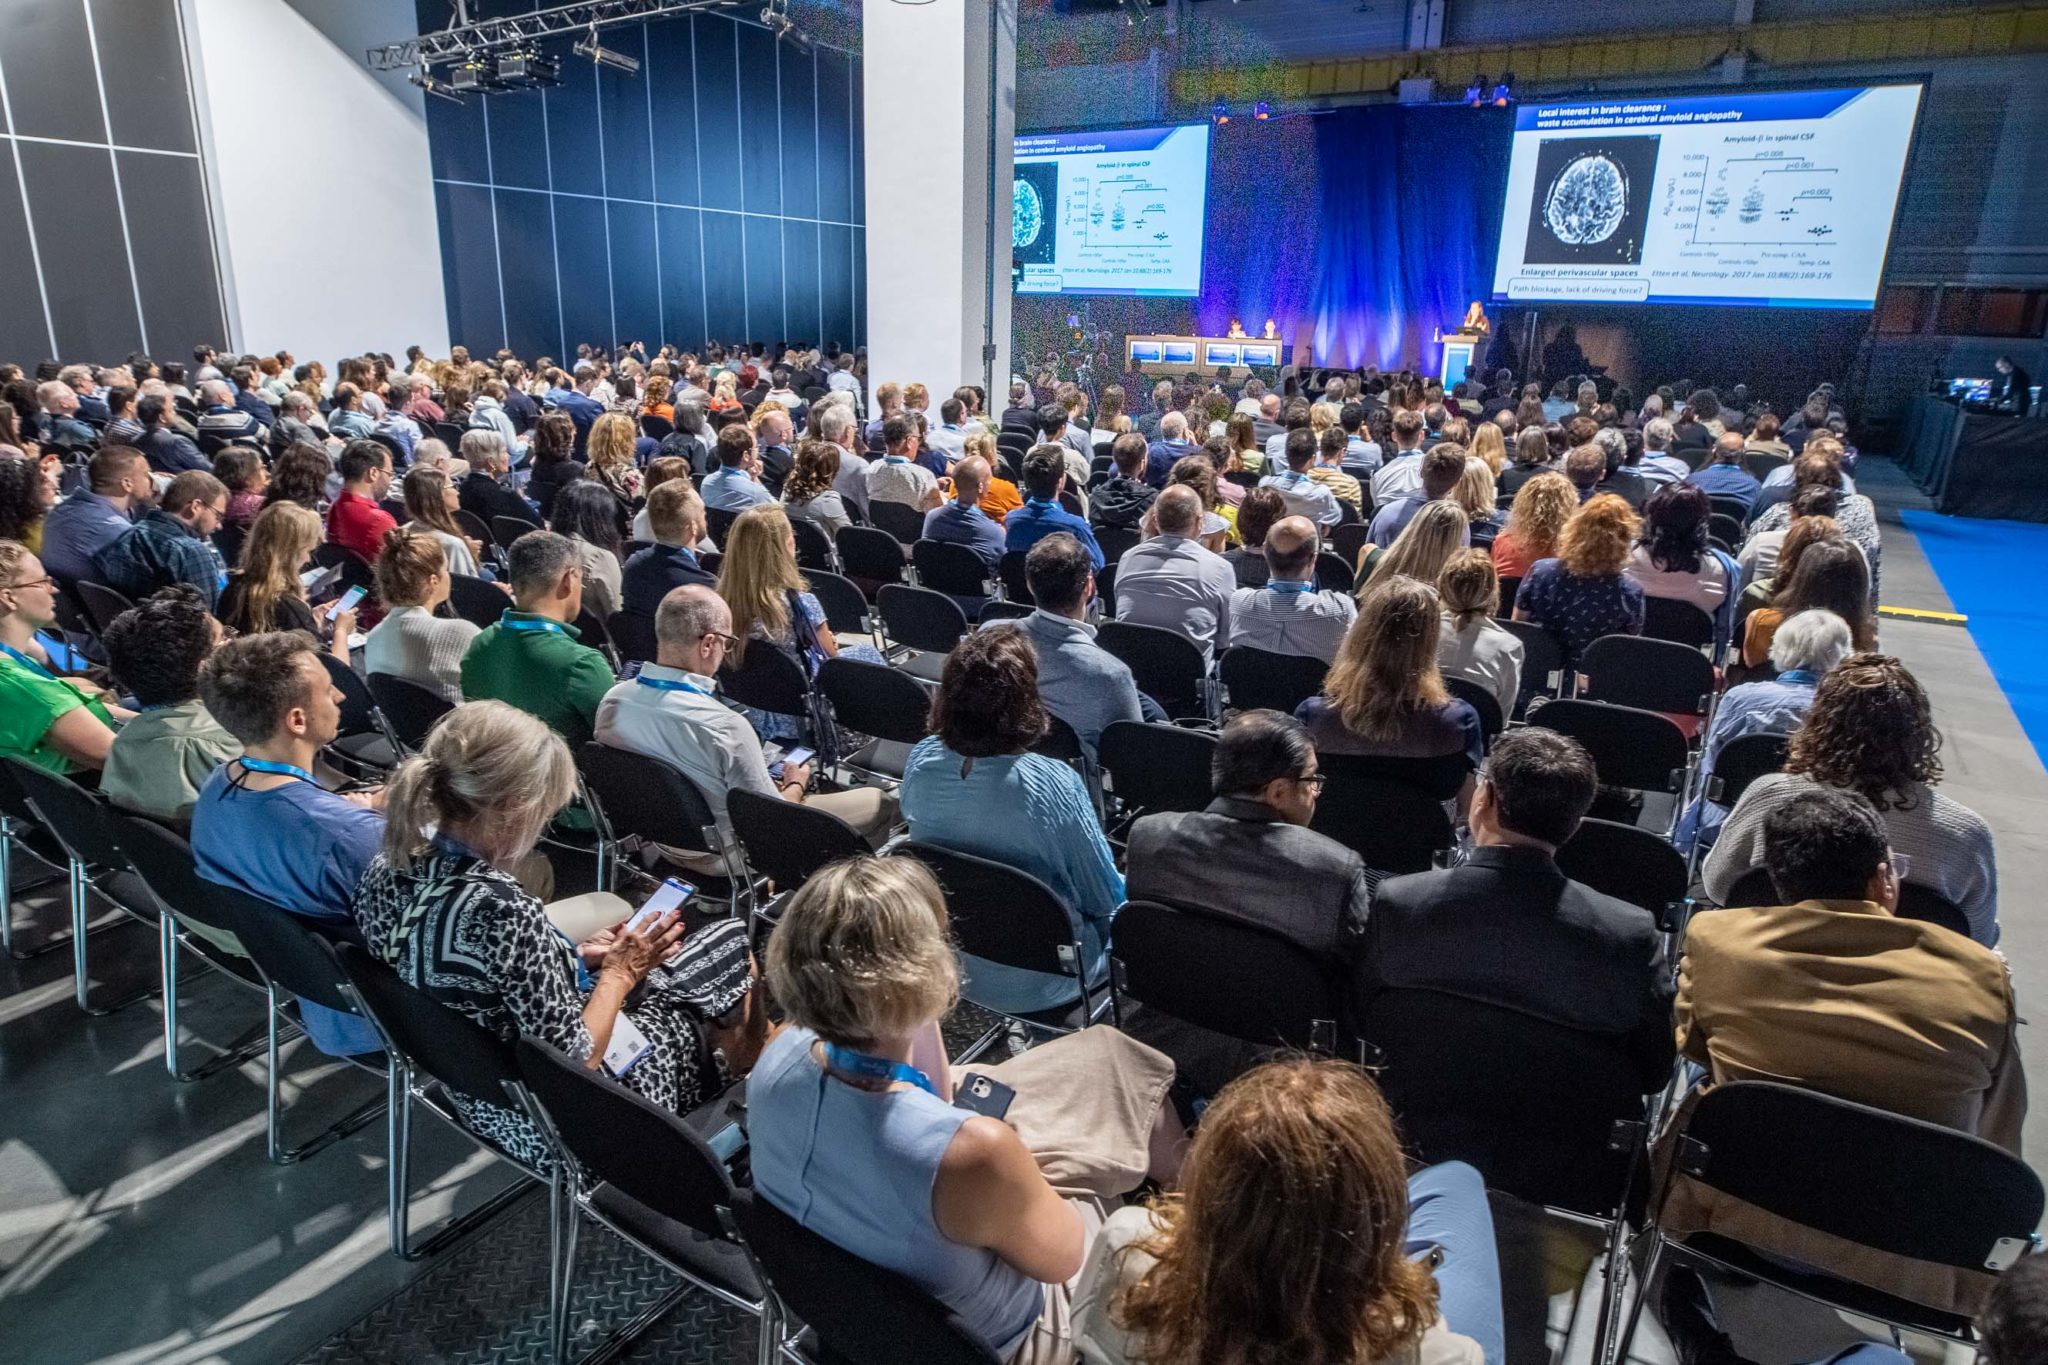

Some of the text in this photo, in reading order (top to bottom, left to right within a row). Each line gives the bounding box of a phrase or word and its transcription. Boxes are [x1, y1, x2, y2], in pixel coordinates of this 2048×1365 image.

[1538, 108, 1558, 118] Local
[1559, 106, 1591, 116] interest
[1591, 106, 1600, 115] in
[1600, 104, 1622, 114] brain
[1623, 104, 1662, 114] clearance
[1537, 110, 1743, 128] waste accumulation in cerebral amyloid angiopathy
[1775, 133, 1799, 143] spinal
[1801, 132, 1816, 141] CSF
[1520, 268, 1639, 279] Enlarged perivascular spaces
[1513, 285, 1530, 293] Path
[1591, 286, 1617, 296] driving
[1618, 286, 1643, 295] force?
